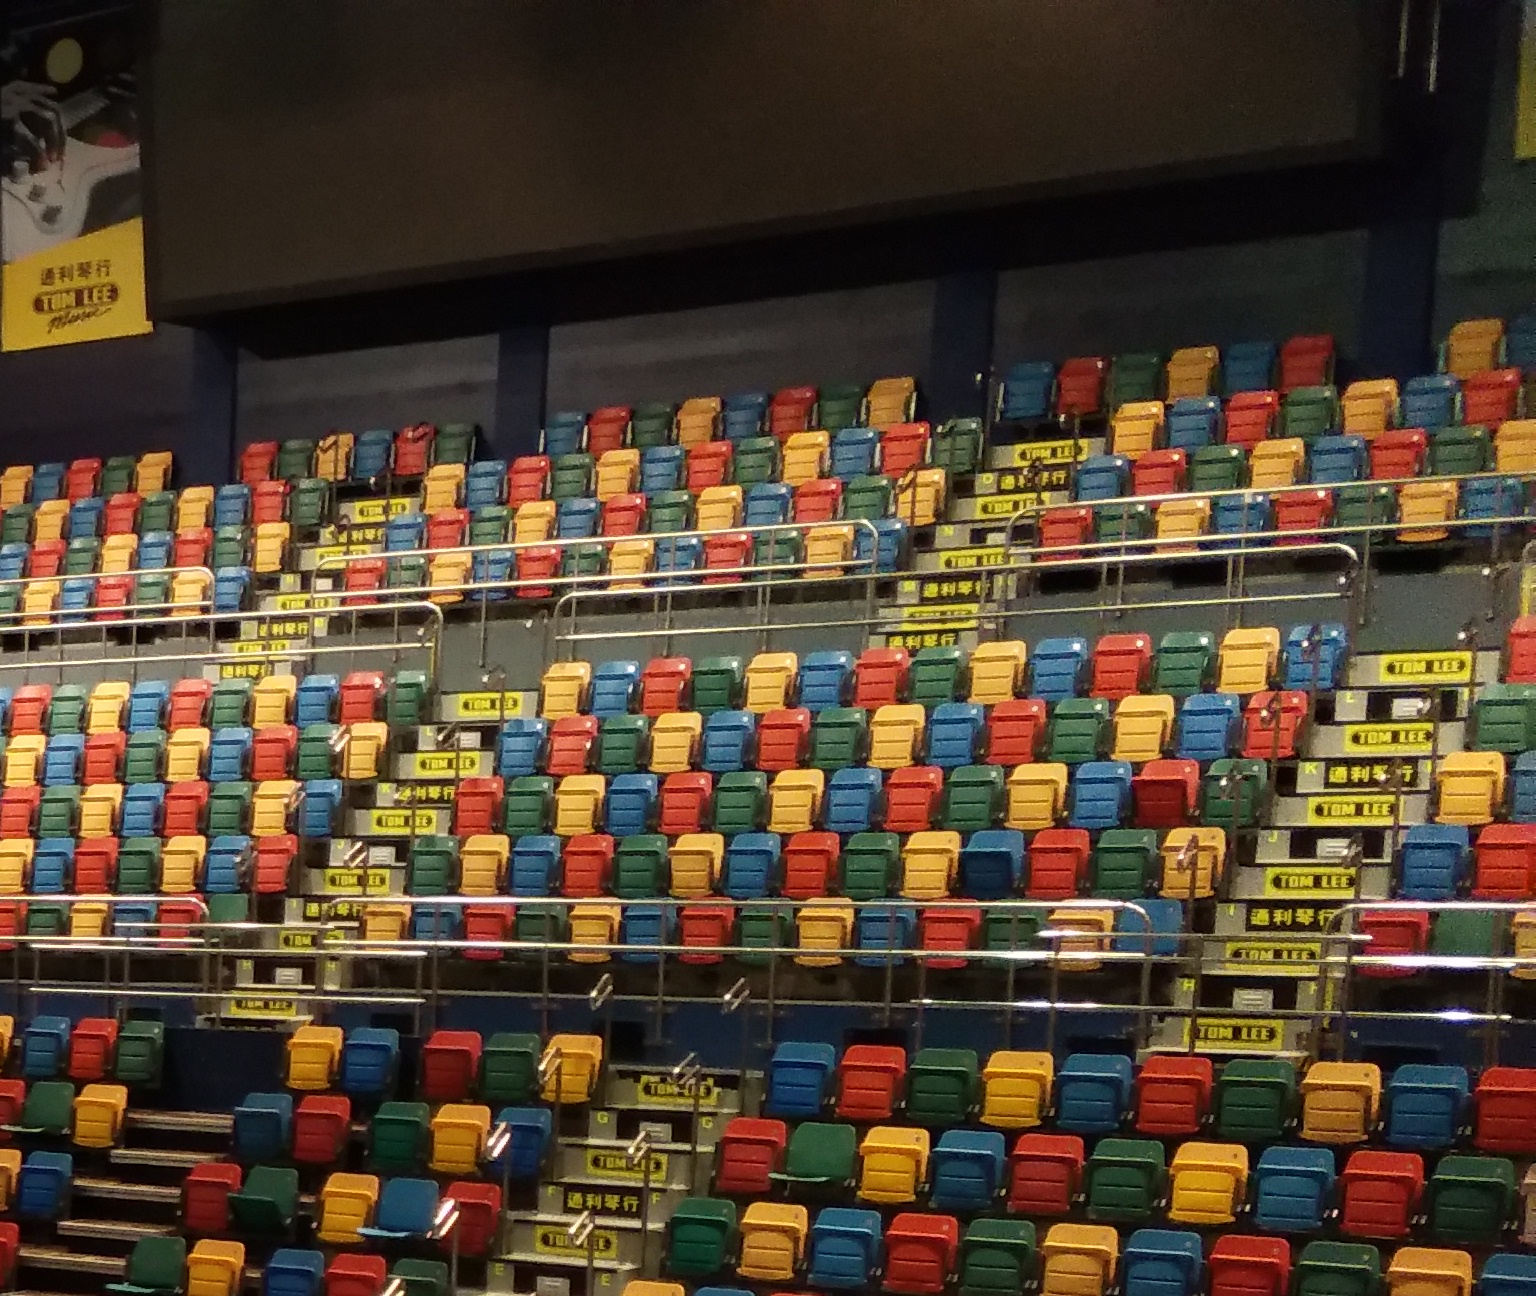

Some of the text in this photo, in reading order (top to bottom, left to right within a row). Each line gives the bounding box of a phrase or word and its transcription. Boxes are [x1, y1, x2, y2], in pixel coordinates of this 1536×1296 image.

[42, 286, 113, 311] TOM LEE
[1393, 659, 1462, 674] TOM LEE
[1358, 730, 1428, 744] TOM LEE
[1321, 802, 1392, 817] TOM LEE
[1279, 874, 1351, 888] TOM LEE
[1197, 1026, 1271, 1041] TOM LEE
[567, 1191, 640, 1213] 通利琴行
